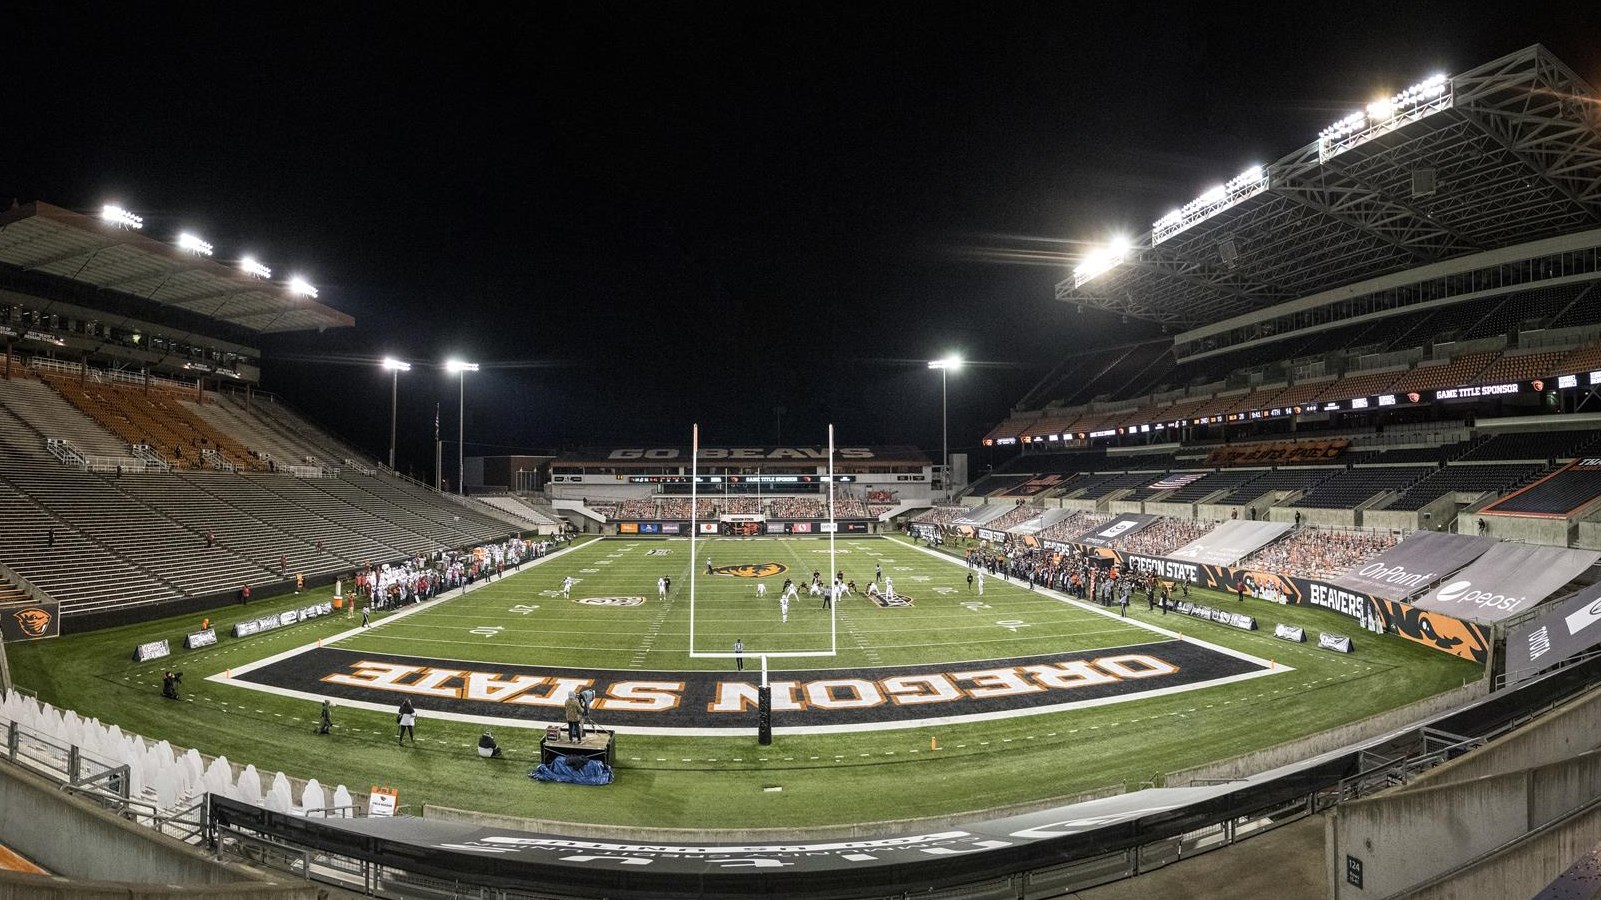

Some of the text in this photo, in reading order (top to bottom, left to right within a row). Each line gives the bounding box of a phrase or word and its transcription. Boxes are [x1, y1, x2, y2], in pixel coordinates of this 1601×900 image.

[1436, 383, 1518, 399] GAME TITLE SPONSOR
[1271, 408, 1281, 416] 4TH
[608, 448, 875, 460] GO BEAVS
[1166, 561, 1197, 582] STATE
[1358, 562, 1433, 587] OnPoint
[1310, 583, 1364, 619] BEAVERS
[1461, 588, 1526, 612] pepsi
[1528, 625, 1551, 661] TOYOTA
[320, 654, 1180, 713] OREGON STATE
